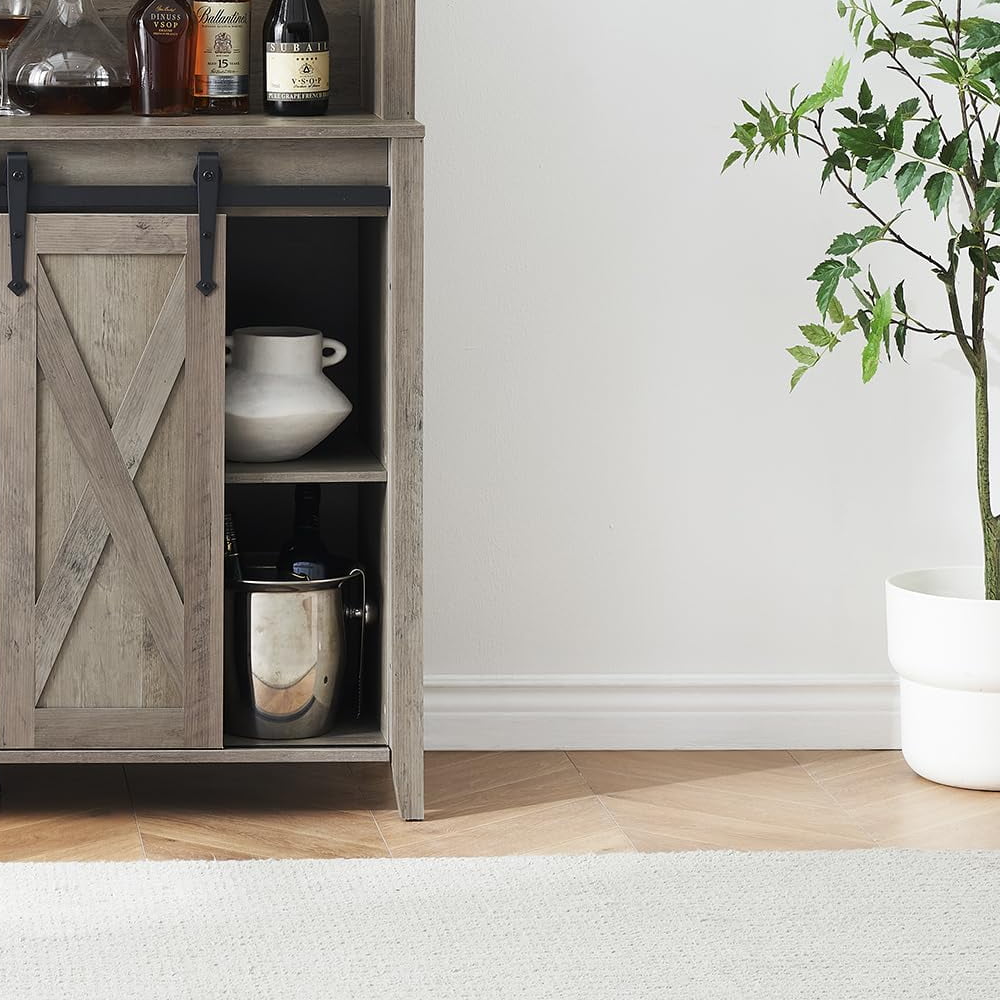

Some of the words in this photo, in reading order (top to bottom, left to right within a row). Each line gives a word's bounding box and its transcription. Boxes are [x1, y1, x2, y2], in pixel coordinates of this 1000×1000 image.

[150, 13, 181, 21] DINUSS
[153, 21, 179, 29] VSOP
[218, 59, 229, 69] 15
